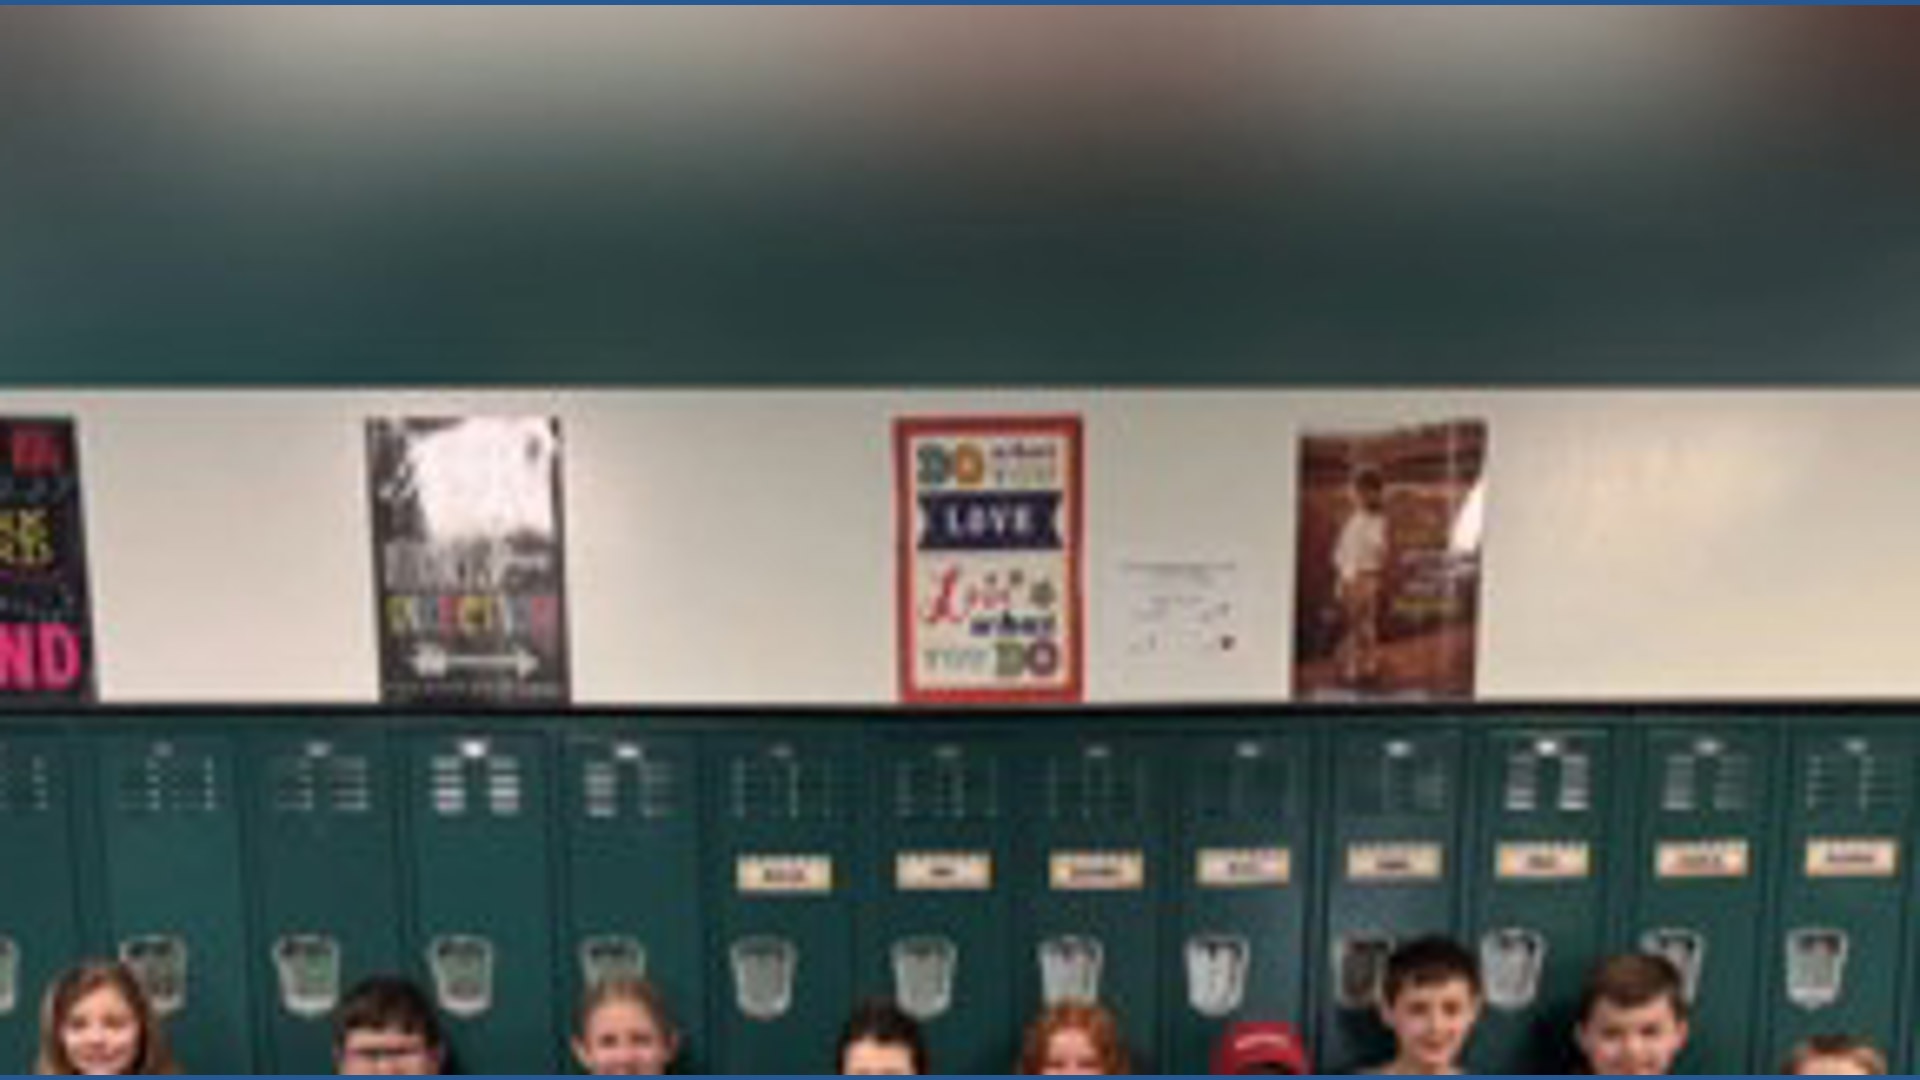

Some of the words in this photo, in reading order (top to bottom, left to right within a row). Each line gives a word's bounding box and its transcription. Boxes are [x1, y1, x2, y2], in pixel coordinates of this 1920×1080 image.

[917, 443, 985, 486] DO
[946, 502, 1036, 536] LOVE
[996, 640, 1059, 677] DO
